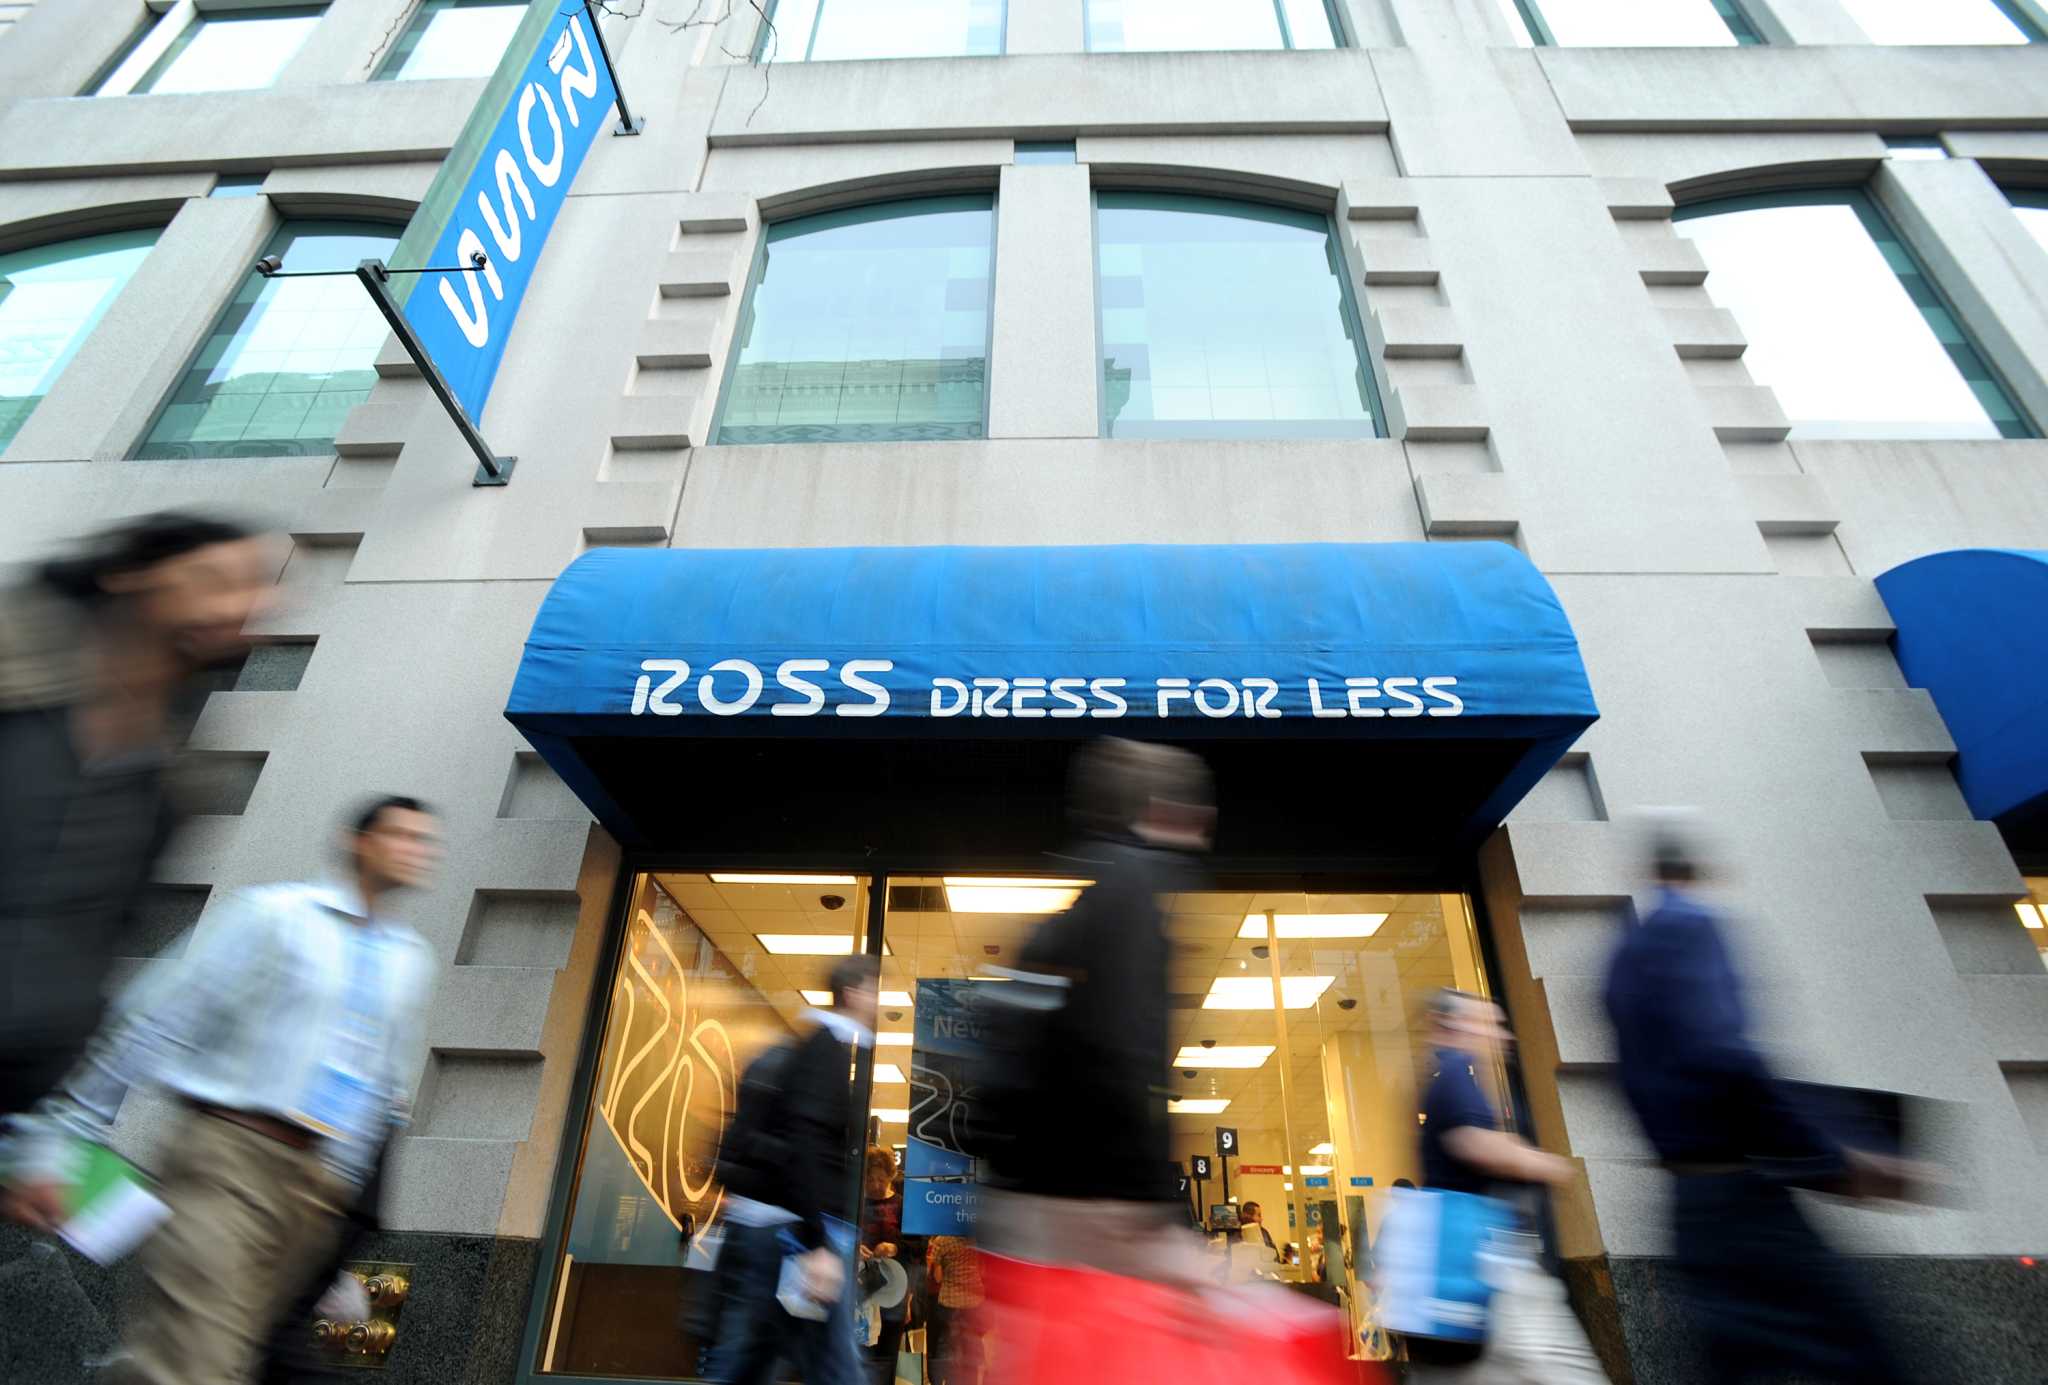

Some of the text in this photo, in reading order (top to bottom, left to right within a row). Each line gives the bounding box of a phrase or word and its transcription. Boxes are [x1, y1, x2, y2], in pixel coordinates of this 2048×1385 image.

[438, 15, 597, 348] ROSS
[630, 658, 1464, 718] ROSS DRESS FOR LESS
[1222, 1131, 1233, 1149] 9
[1197, 1159, 1207, 1174] 8
[1179, 1178, 1187, 1191] 7
[925, 1190, 962, 1204] Come
